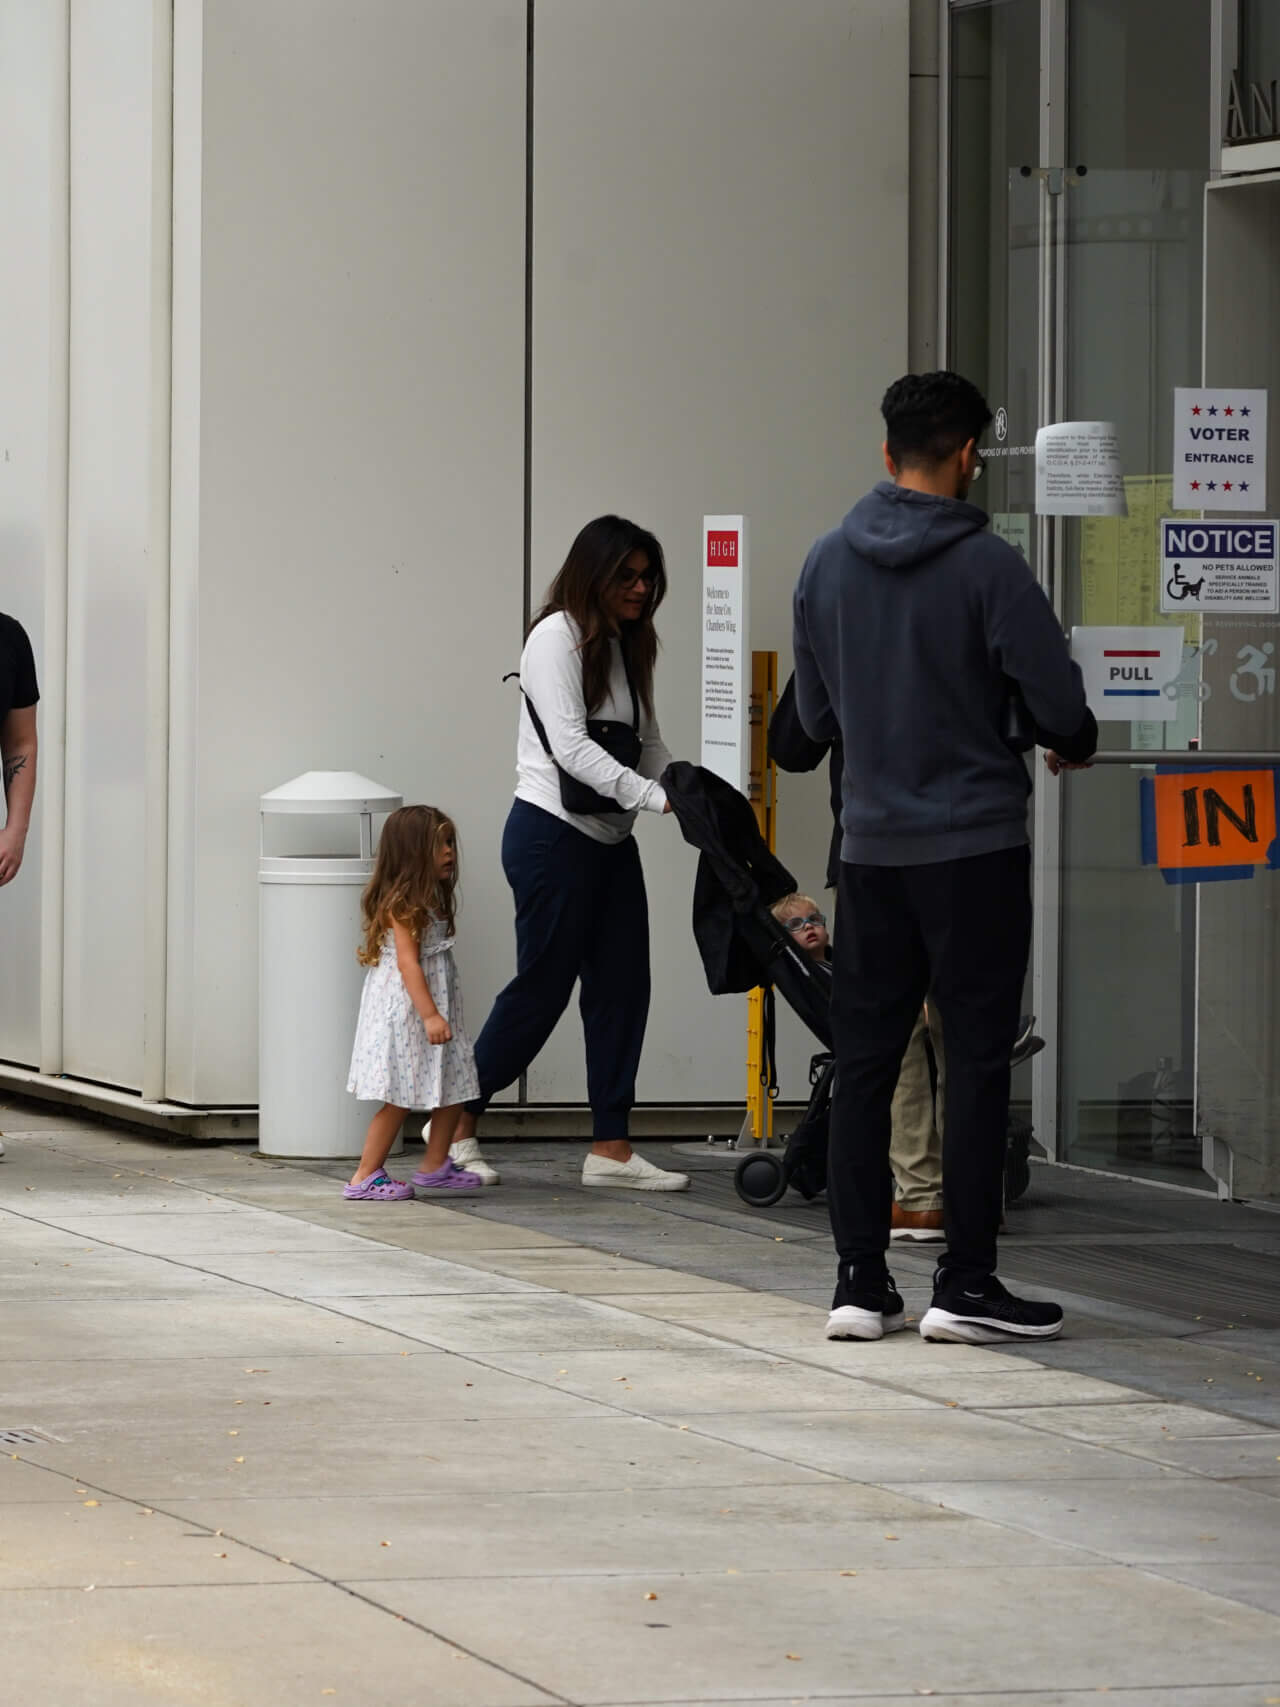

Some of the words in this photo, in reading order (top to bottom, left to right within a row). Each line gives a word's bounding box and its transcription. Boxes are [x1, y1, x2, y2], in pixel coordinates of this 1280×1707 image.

[1190, 427, 1250, 441] VOTER
[1185, 453, 1254, 464] ENTRANCE
[710, 540, 735, 557] HIGH
[1168, 529, 1272, 553] NOTICE
[1109, 666, 1154, 682] PULL
[1182, 784, 1258, 847] IN
